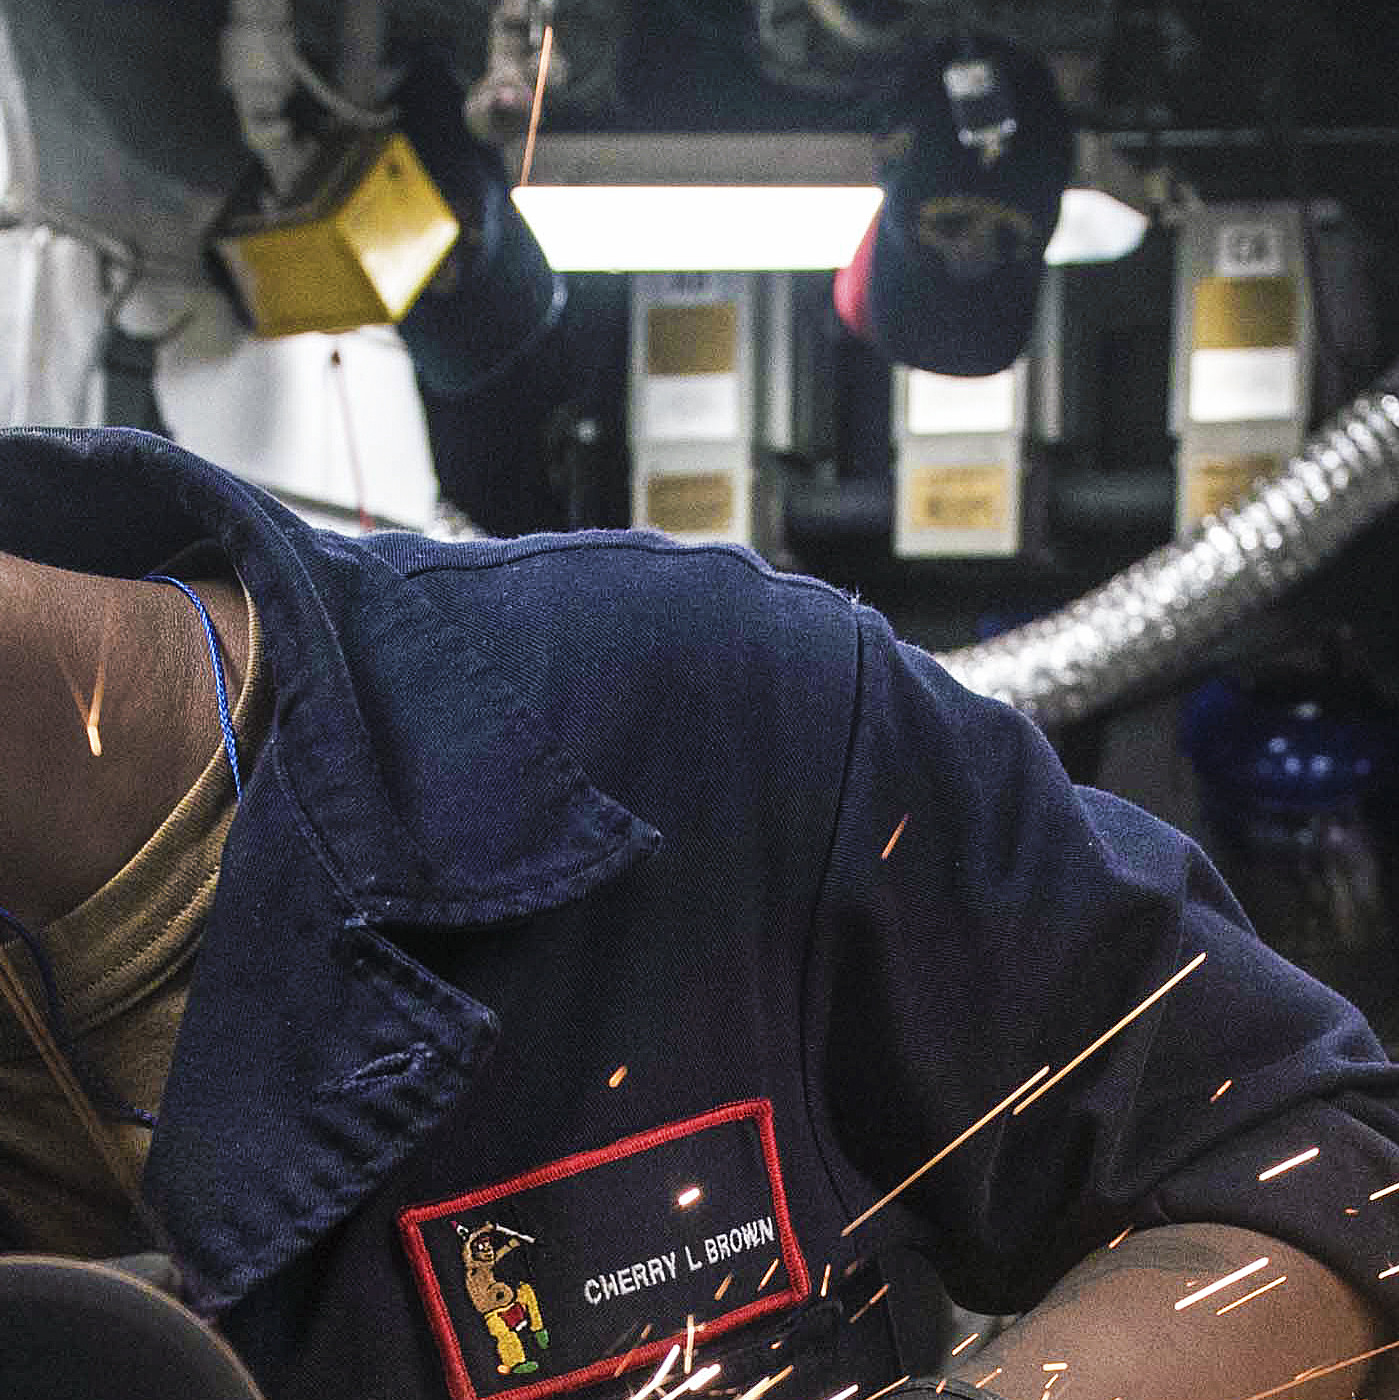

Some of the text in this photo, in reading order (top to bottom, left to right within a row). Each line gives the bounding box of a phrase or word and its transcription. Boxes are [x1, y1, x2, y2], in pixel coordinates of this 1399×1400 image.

[584, 1217, 775, 1304] CHERRY L BROWN
